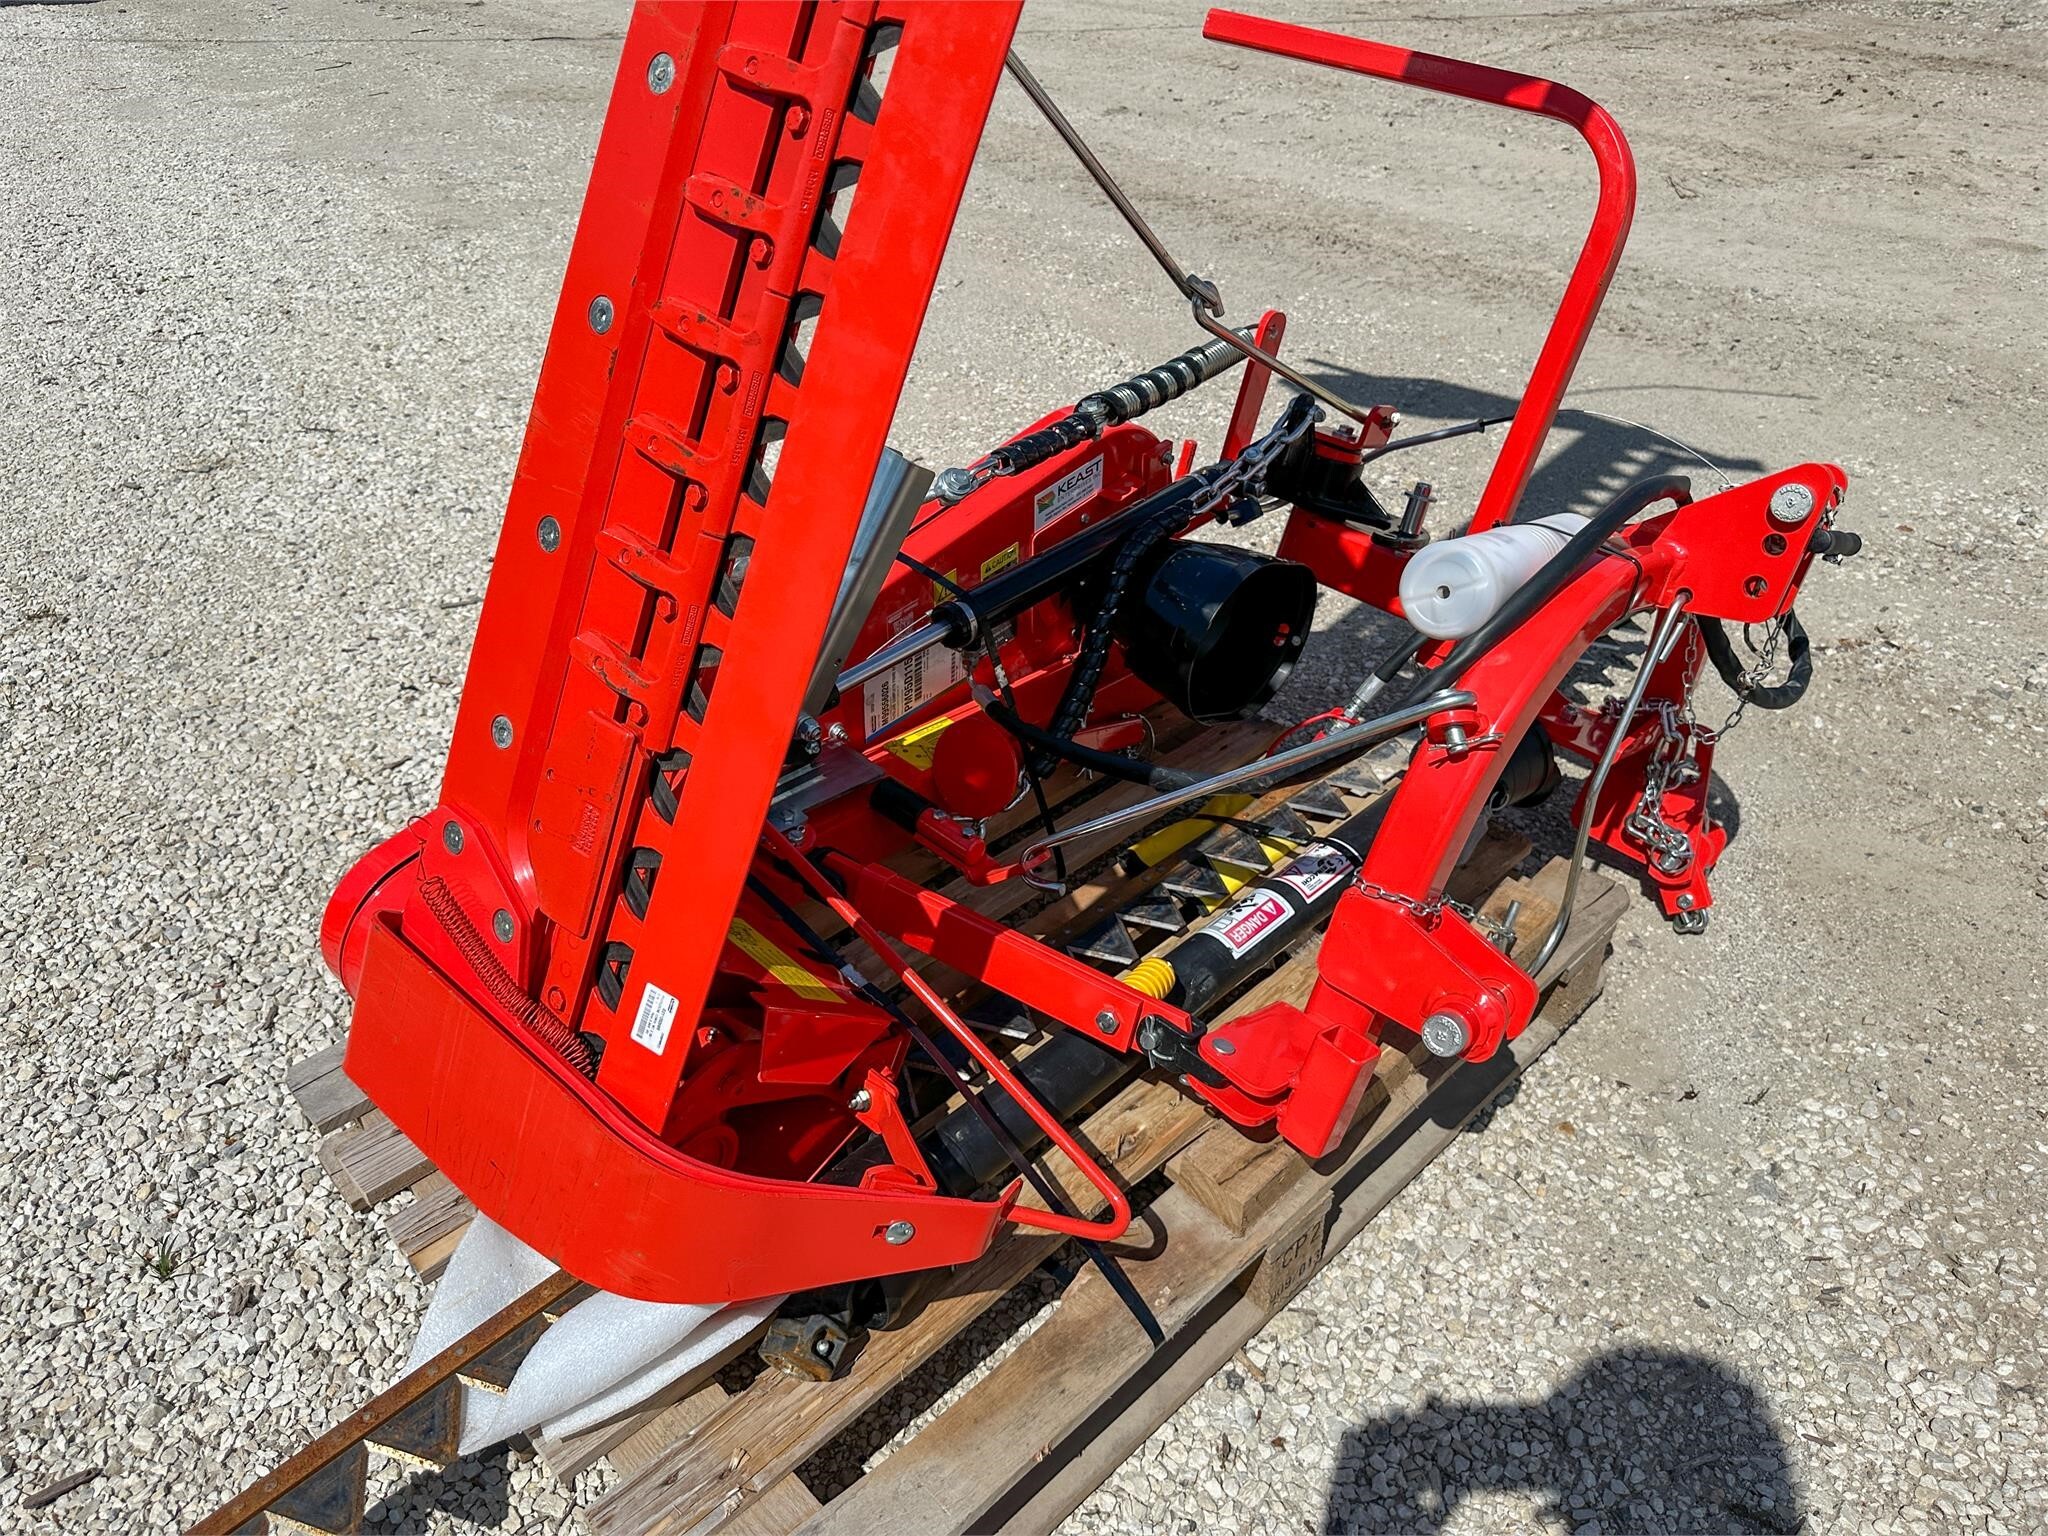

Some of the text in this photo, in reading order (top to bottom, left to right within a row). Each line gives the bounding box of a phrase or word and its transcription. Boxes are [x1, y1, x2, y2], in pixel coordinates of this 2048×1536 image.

[1058, 459, 1102, 496] KEAST
[904, 657, 914, 712] PM95D115
[1230, 911, 1269, 943] DANGER
